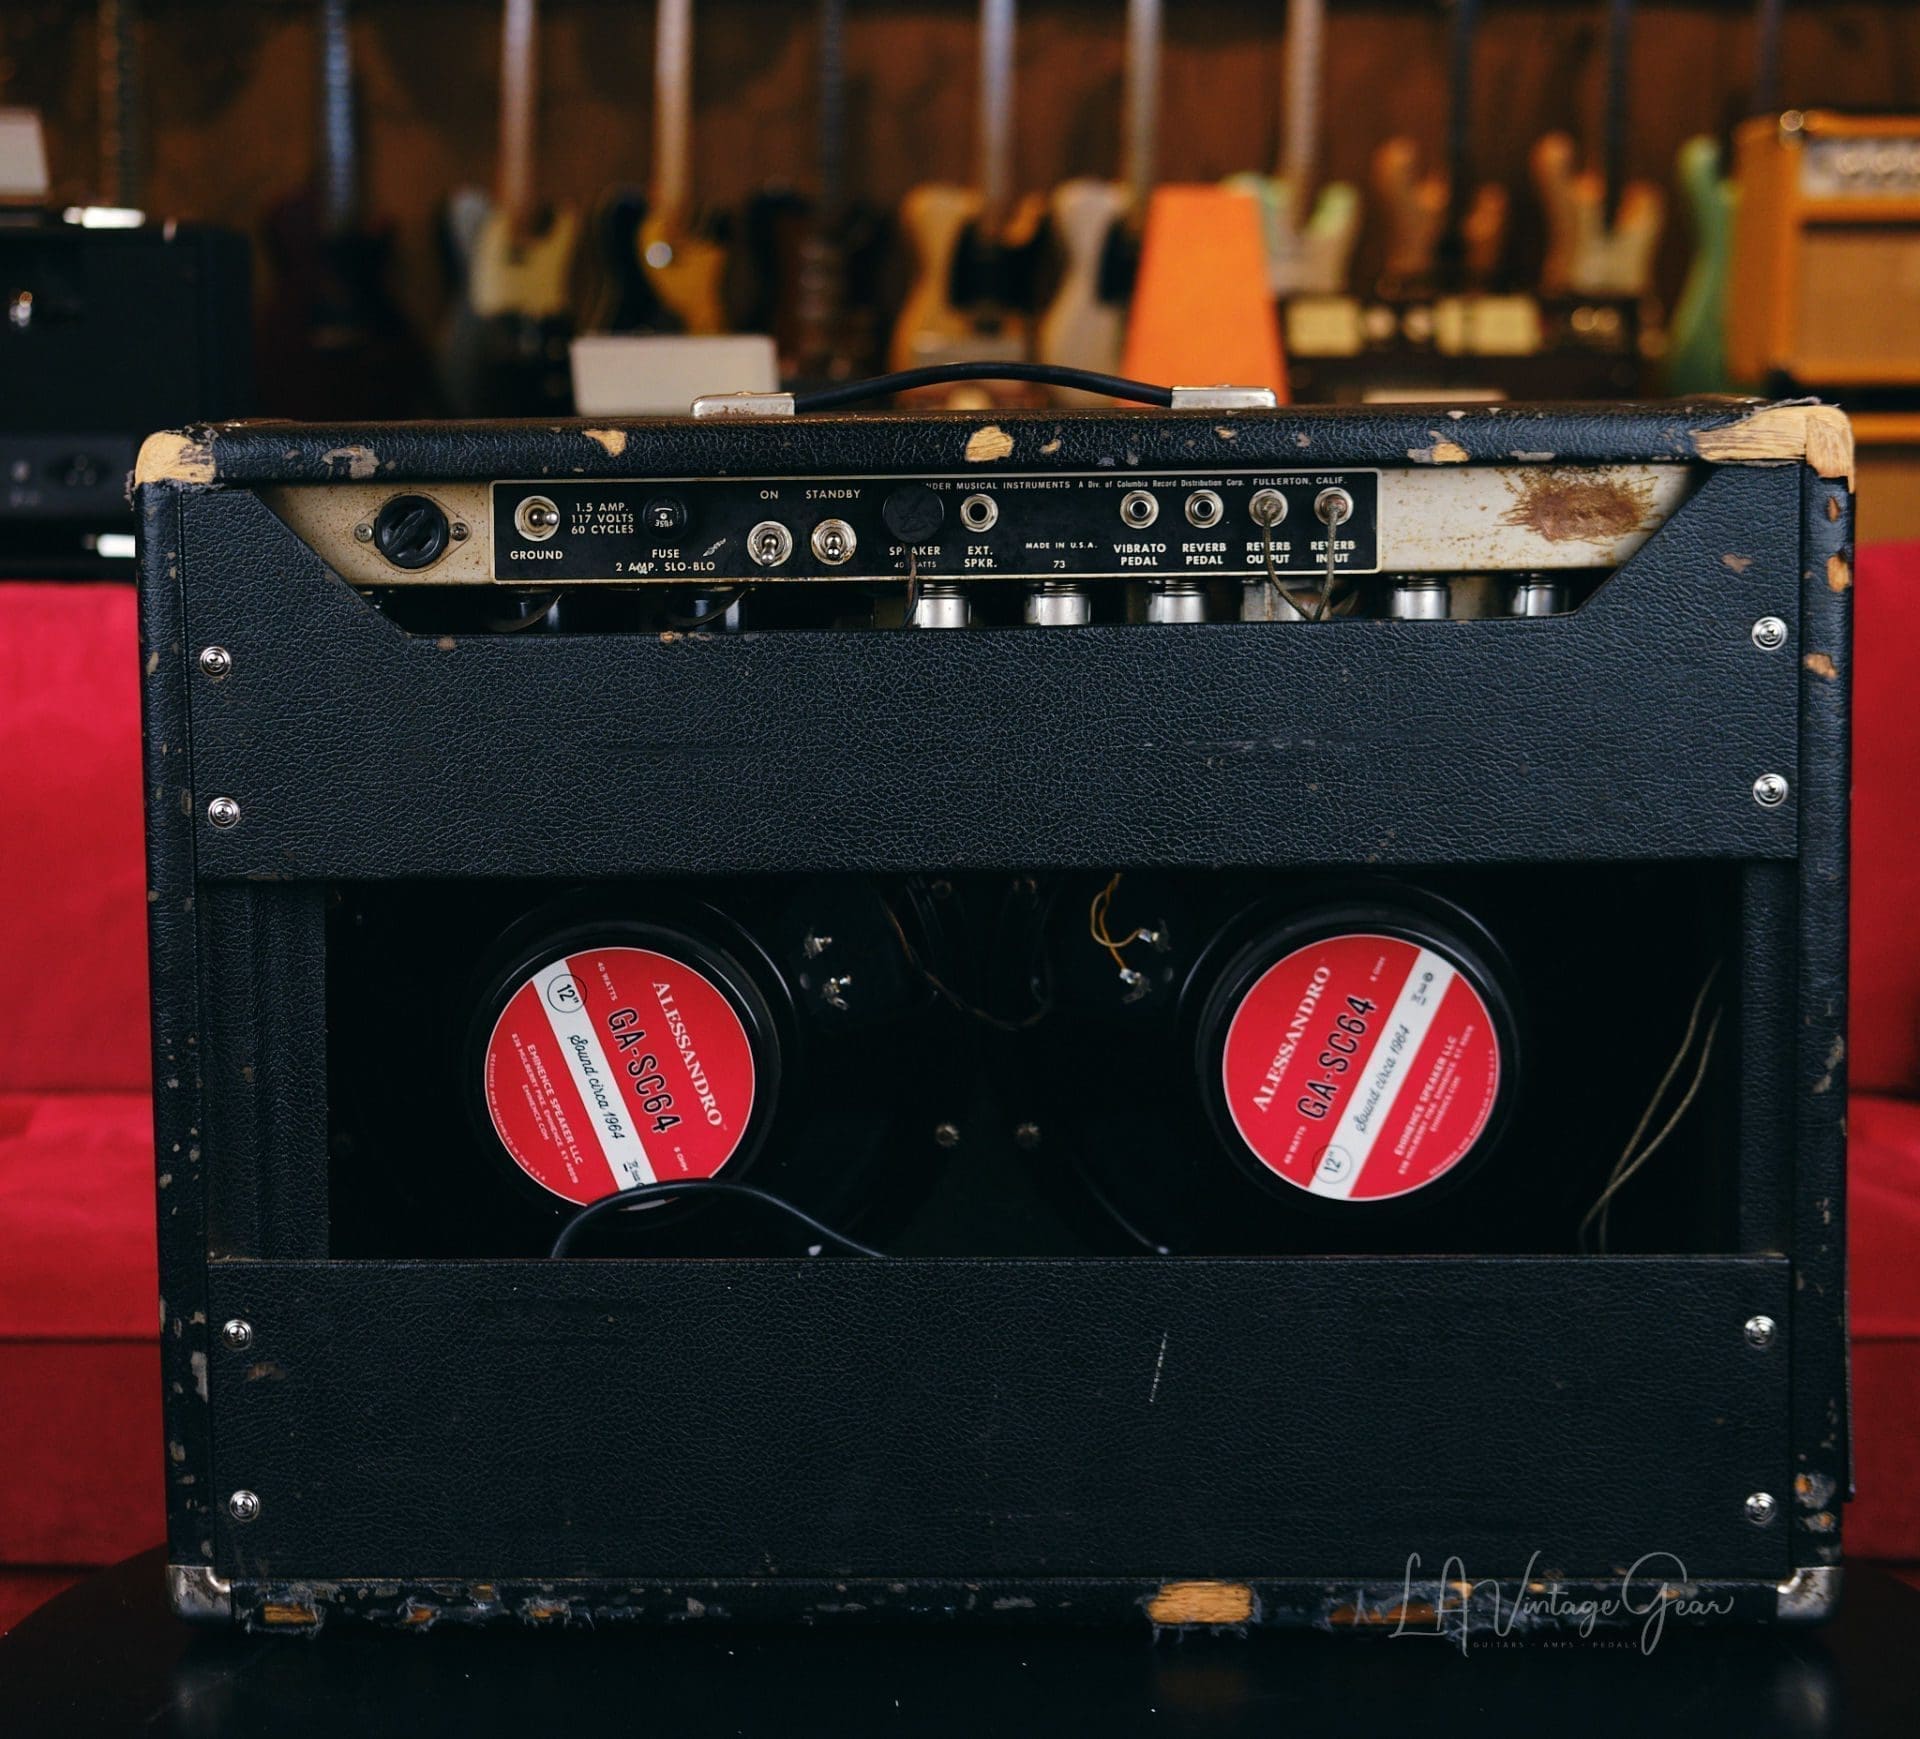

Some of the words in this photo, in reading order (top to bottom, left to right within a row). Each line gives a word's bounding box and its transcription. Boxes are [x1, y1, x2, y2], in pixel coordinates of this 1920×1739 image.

[956, 481, 998, 490] MUSICAL
[1002, 480, 1071, 490] INSTRUMENTS
[1088, 480, 1101, 489] Div.
[1105, 480, 1113, 488] of
[1116, 480, 1148, 488] Columbia
[1152, 480, 1177, 488] Record
[1180, 479, 1223, 487] Distribution
[1226, 479, 1245, 488] Corp.
[1315, 476, 1348, 485] CALIF.
[759, 490, 779, 500] ON
[805, 489, 861, 500] STANDBY
[575, 503, 593, 512] 1.5
[598, 502, 629, 512] AMP.
[571, 514, 591, 524] 117
[597, 513, 634, 523] VOLTS
[571, 525, 586, 535] 60
[591, 525, 634, 535] CYCLES
[888, 545, 941, 556] SPAKER
[967, 545, 993, 556] EXT.
[1070, 541, 1098, 549] U.S.A.
[1113, 543, 1167, 554] VIBRATO
[1182, 543, 1227, 553] REVERB
[510, 550, 564, 560] GROUND
[652, 549, 680, 558] FUSE
[1315, 553, 1349, 564] INUT
[894, 561, 905, 569] 40
[964, 557, 997, 568] SPKR.
[1052, 560, 1066, 569] 73
[1120, 555, 1158, 566] PEDAL
[1185, 554, 1224, 566] PEDAL
[615, 563, 623, 572] 2
[628, 562, 658, 572] AMP.
[664, 561, 716, 572] SLO-BLO
[598, 962, 605, 972] 40
[602, 973, 618, 1001] WATTS
[557, 984, 579, 1003] 12"
[1253, 967, 1330, 1112] ALESSANDRO
[653, 983, 722, 1125] ALESSANDRO
[1296, 994, 1378, 1121] GA-SC64
[607, 1007, 683, 1134] GA-SC64
[567, 1034, 598, 1076] Sound
[588, 1078, 609, 1109] circa
[603, 1112, 625, 1139] 1964
[1353, 1088, 1381, 1134] Sound
[1375, 1057, 1396, 1090] circa
[527, 1044, 555, 1096] EMINENCE
[550, 1098, 574, 1144] SPEAKER
[569, 1144, 583, 1164] LLC
